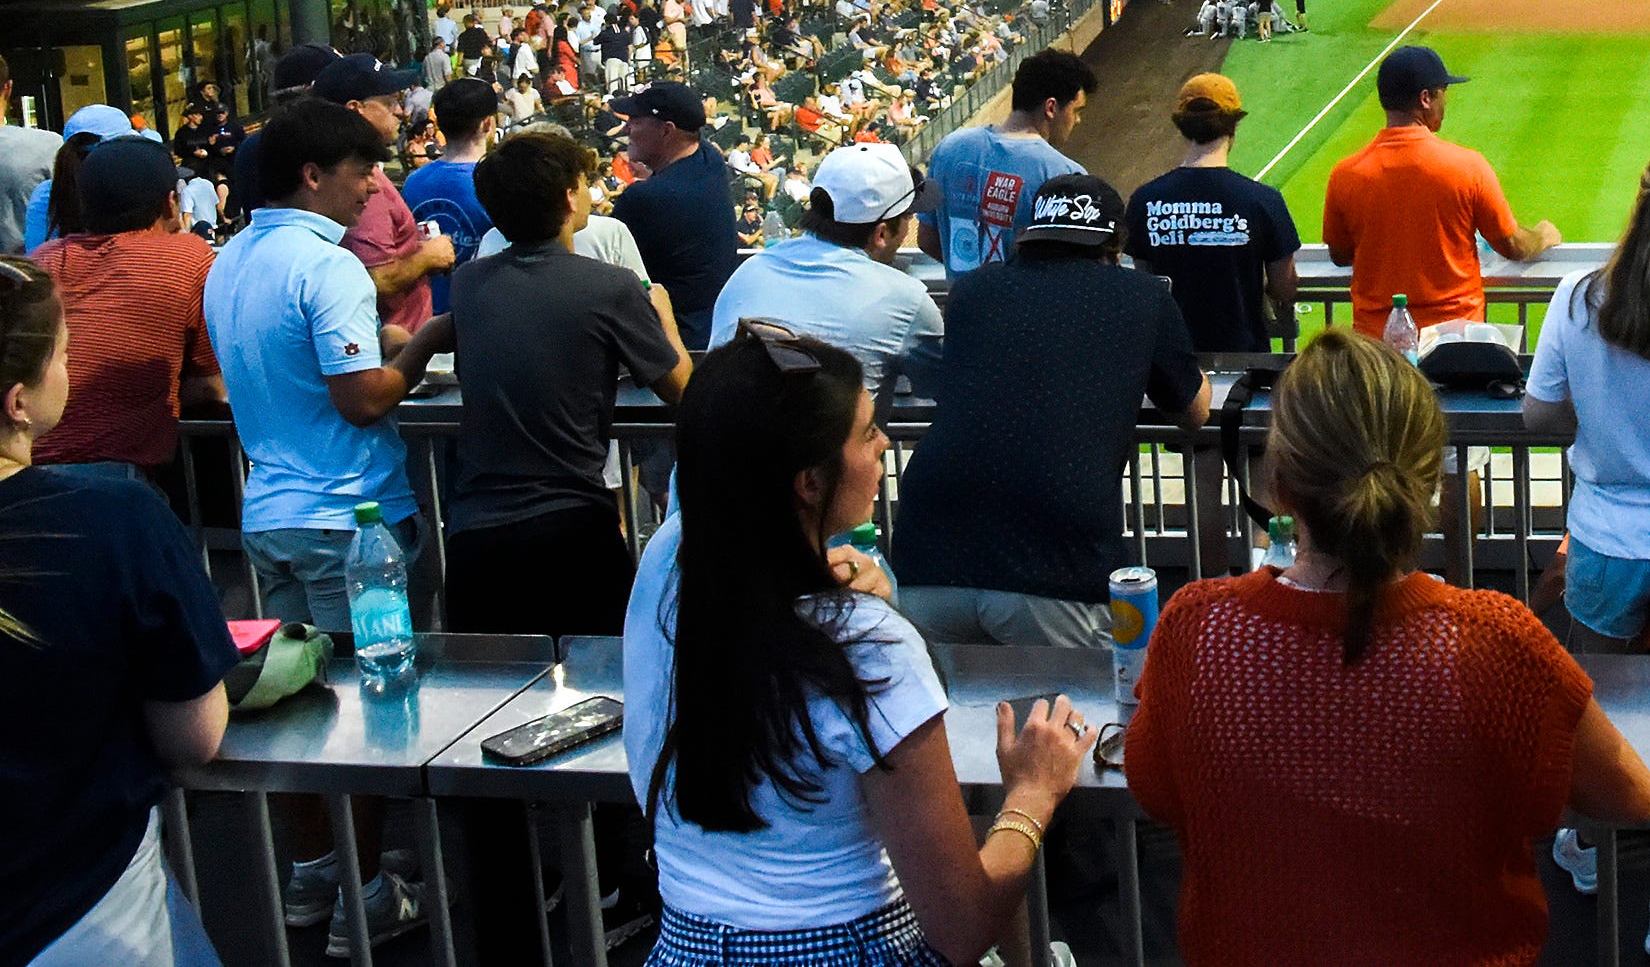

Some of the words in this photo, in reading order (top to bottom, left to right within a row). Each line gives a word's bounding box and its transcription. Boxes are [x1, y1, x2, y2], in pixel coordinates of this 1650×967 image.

[994, 176, 1016, 190] WAR
[986, 186, 1017, 202] EAGLE
[1034, 194, 1073, 223] White
[1070, 195, 1101, 224] Sox
[1146, 200, 1223, 216] Momma
[1146, 214, 1249, 232] Goldberg's
[1148, 230, 1185, 247] Deli
